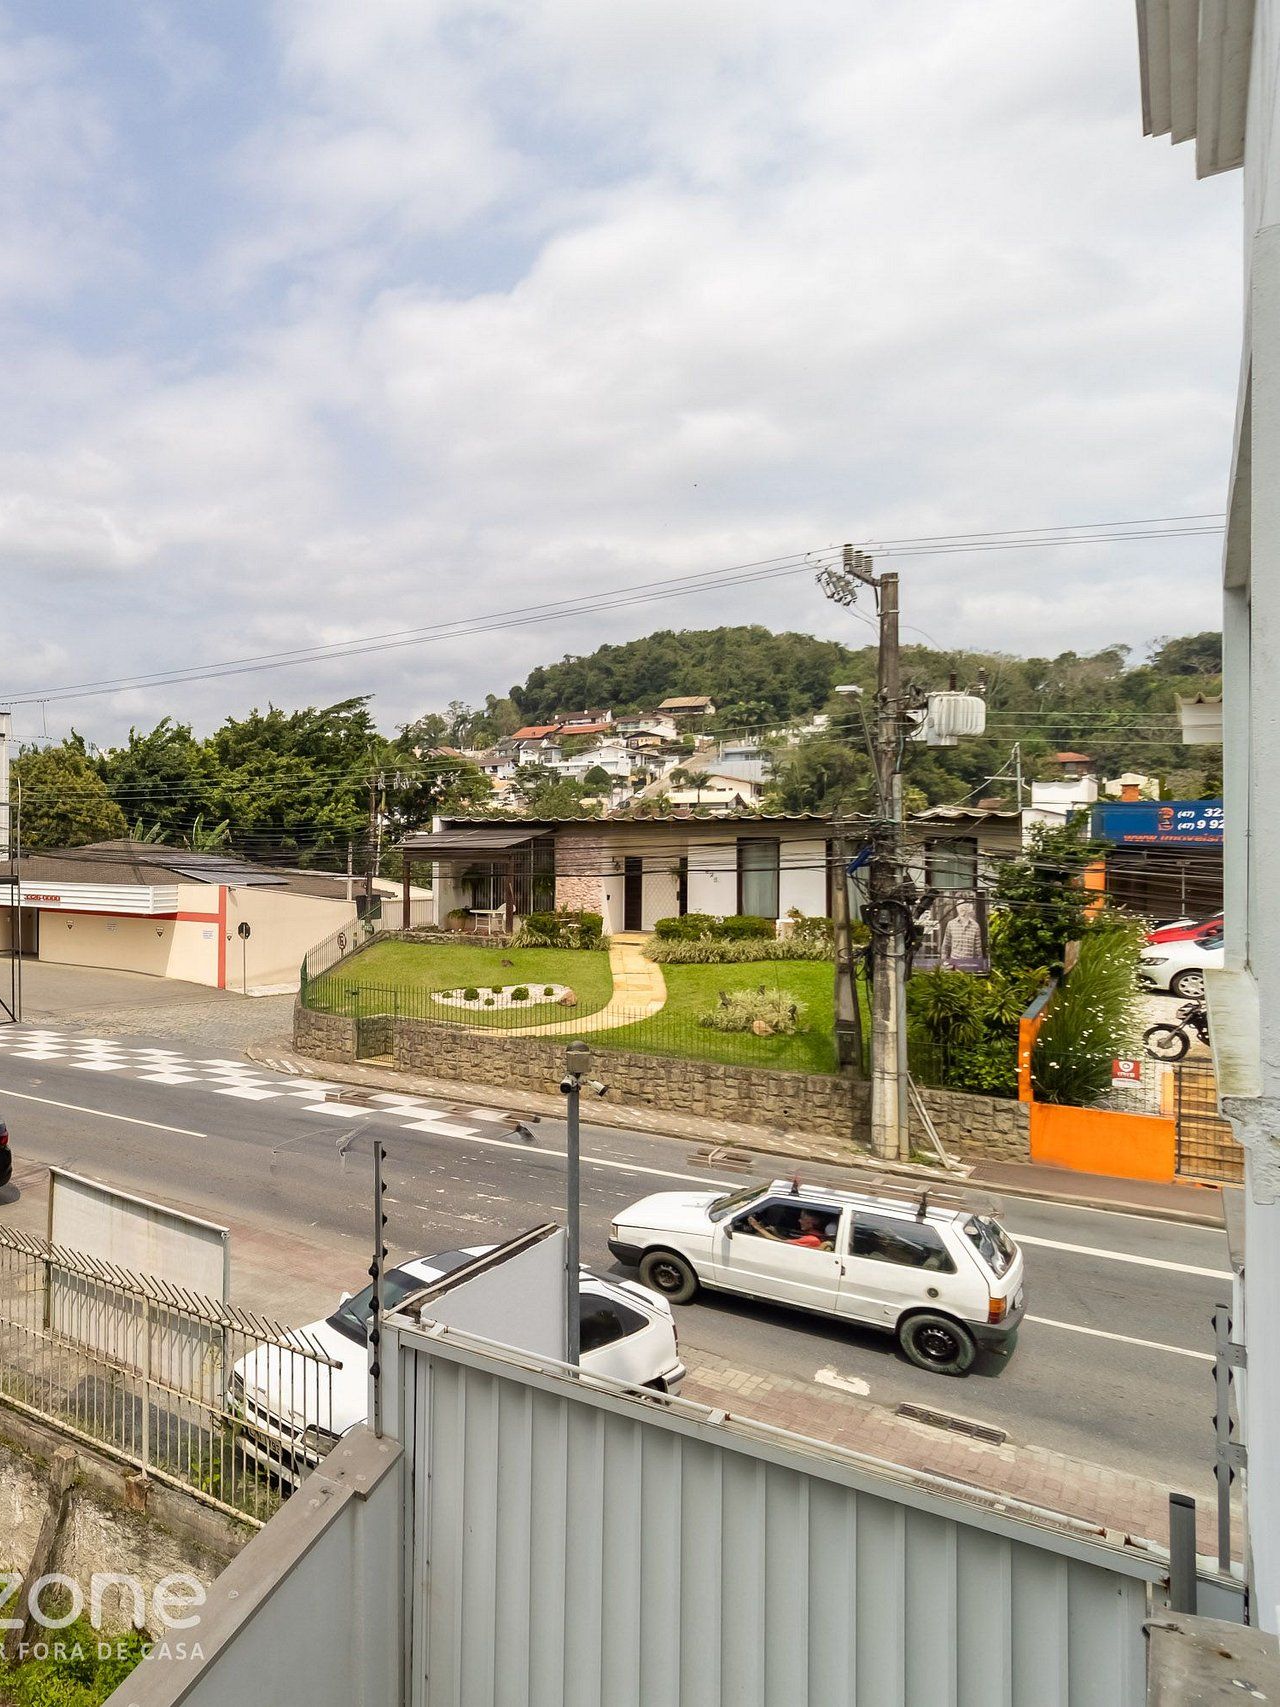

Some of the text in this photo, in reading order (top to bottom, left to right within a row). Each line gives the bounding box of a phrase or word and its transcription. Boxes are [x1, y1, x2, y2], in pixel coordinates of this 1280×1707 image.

[1177, 810, 1195, 819] (47)
[1177, 822, 1195, 831] (47)
[1196, 819, 1207, 829] 9
